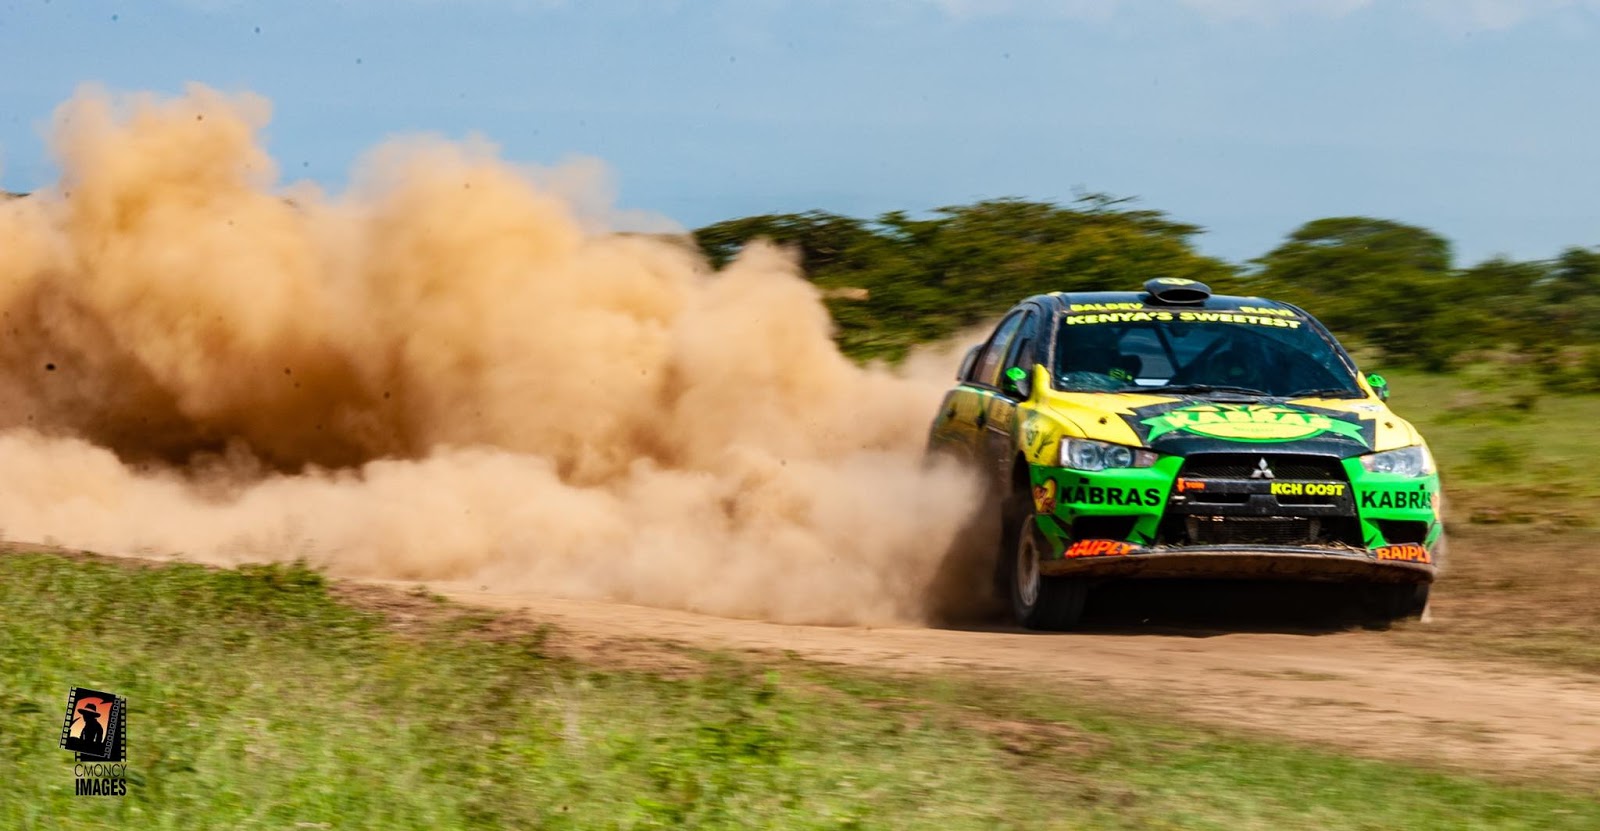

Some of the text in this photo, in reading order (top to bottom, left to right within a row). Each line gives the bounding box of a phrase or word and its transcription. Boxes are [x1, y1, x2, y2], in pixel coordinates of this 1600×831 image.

[1070, 302, 1143, 312] BALDEV
[1066, 311, 1301, 329] KENYA'S SWEETEST
[1060, 486, 1161, 506] KABRAS
[1270, 482, 1303, 495] KCH
